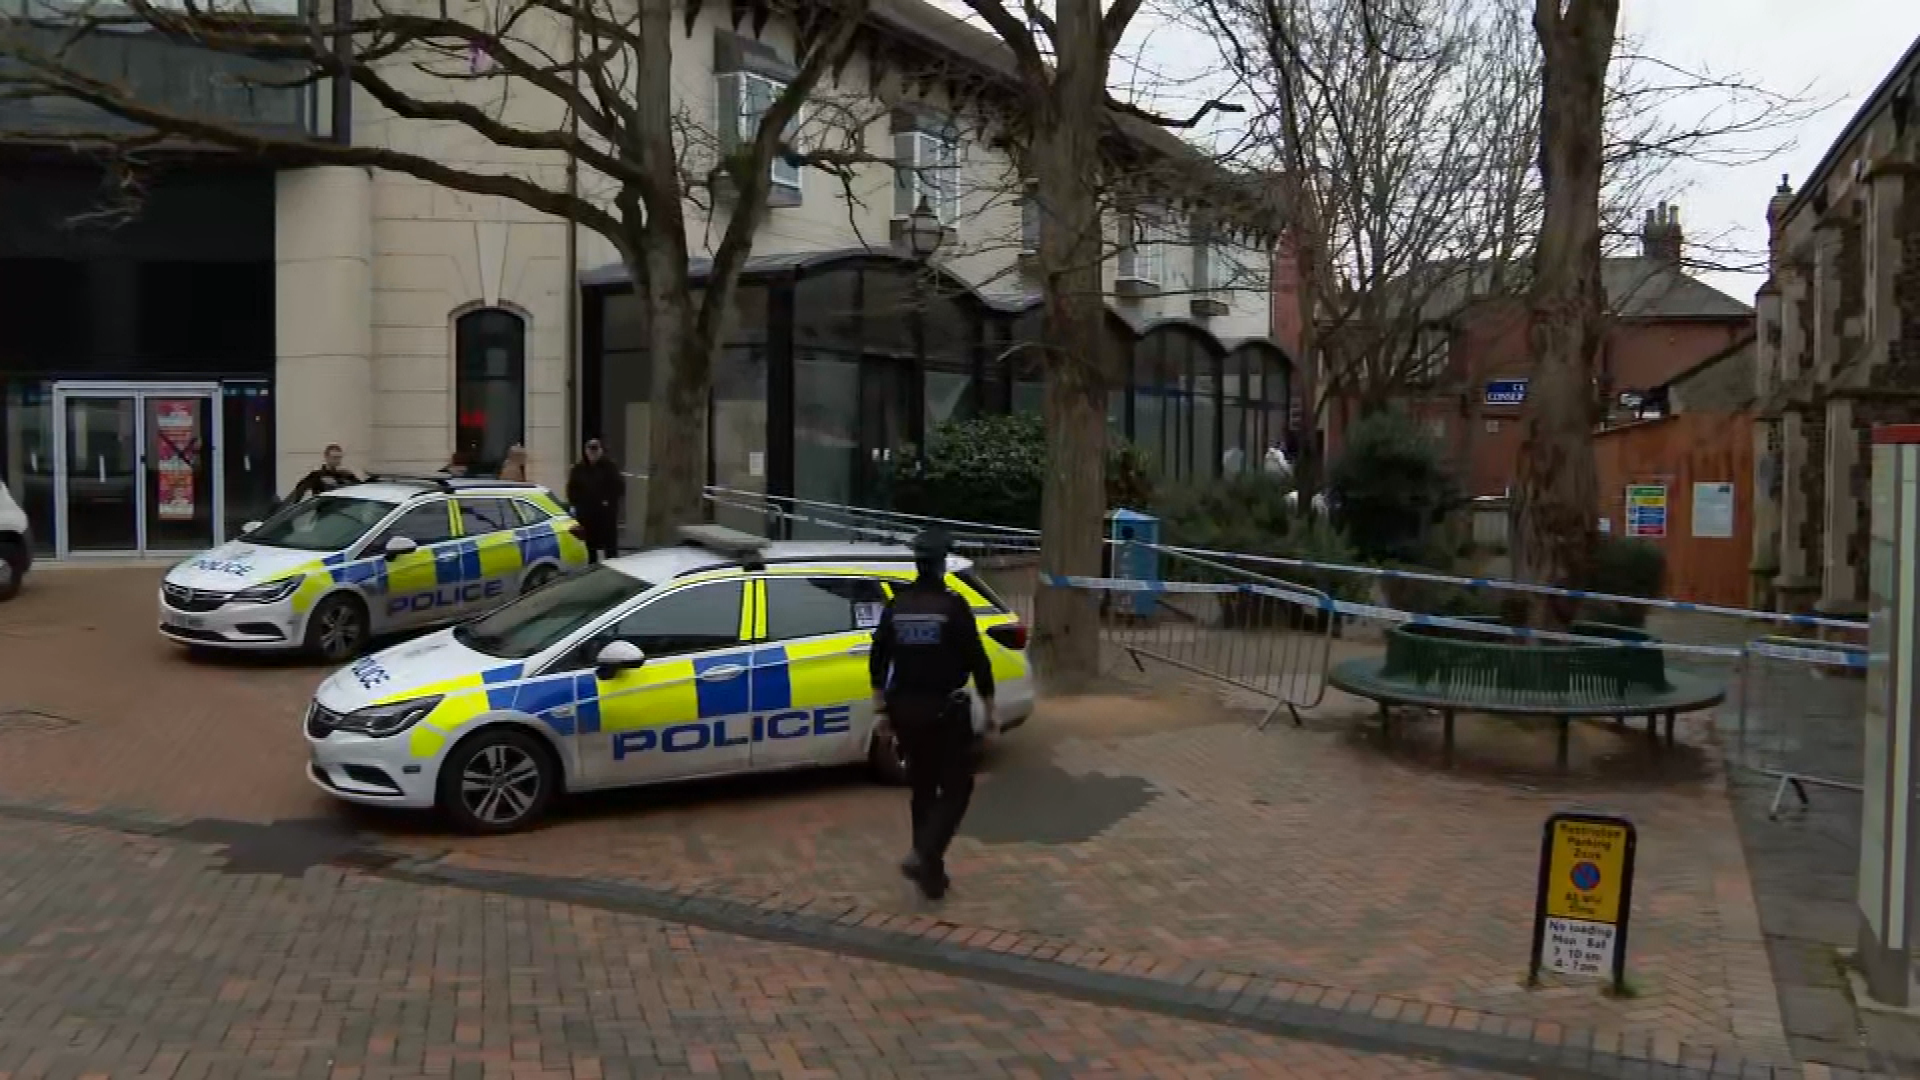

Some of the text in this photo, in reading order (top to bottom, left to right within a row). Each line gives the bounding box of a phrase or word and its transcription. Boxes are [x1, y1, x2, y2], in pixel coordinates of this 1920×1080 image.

[386, 579, 503, 617] POLICE
[613, 705, 849, 760] POLICE
[1567, 836, 1611, 851] Parking
[1573, 848, 1601, 859] Zone
[1549, 919, 1612, 938] No loading
[1552, 934, 1577, 944] Mon
[1587, 938, 1606, 949] Sat
